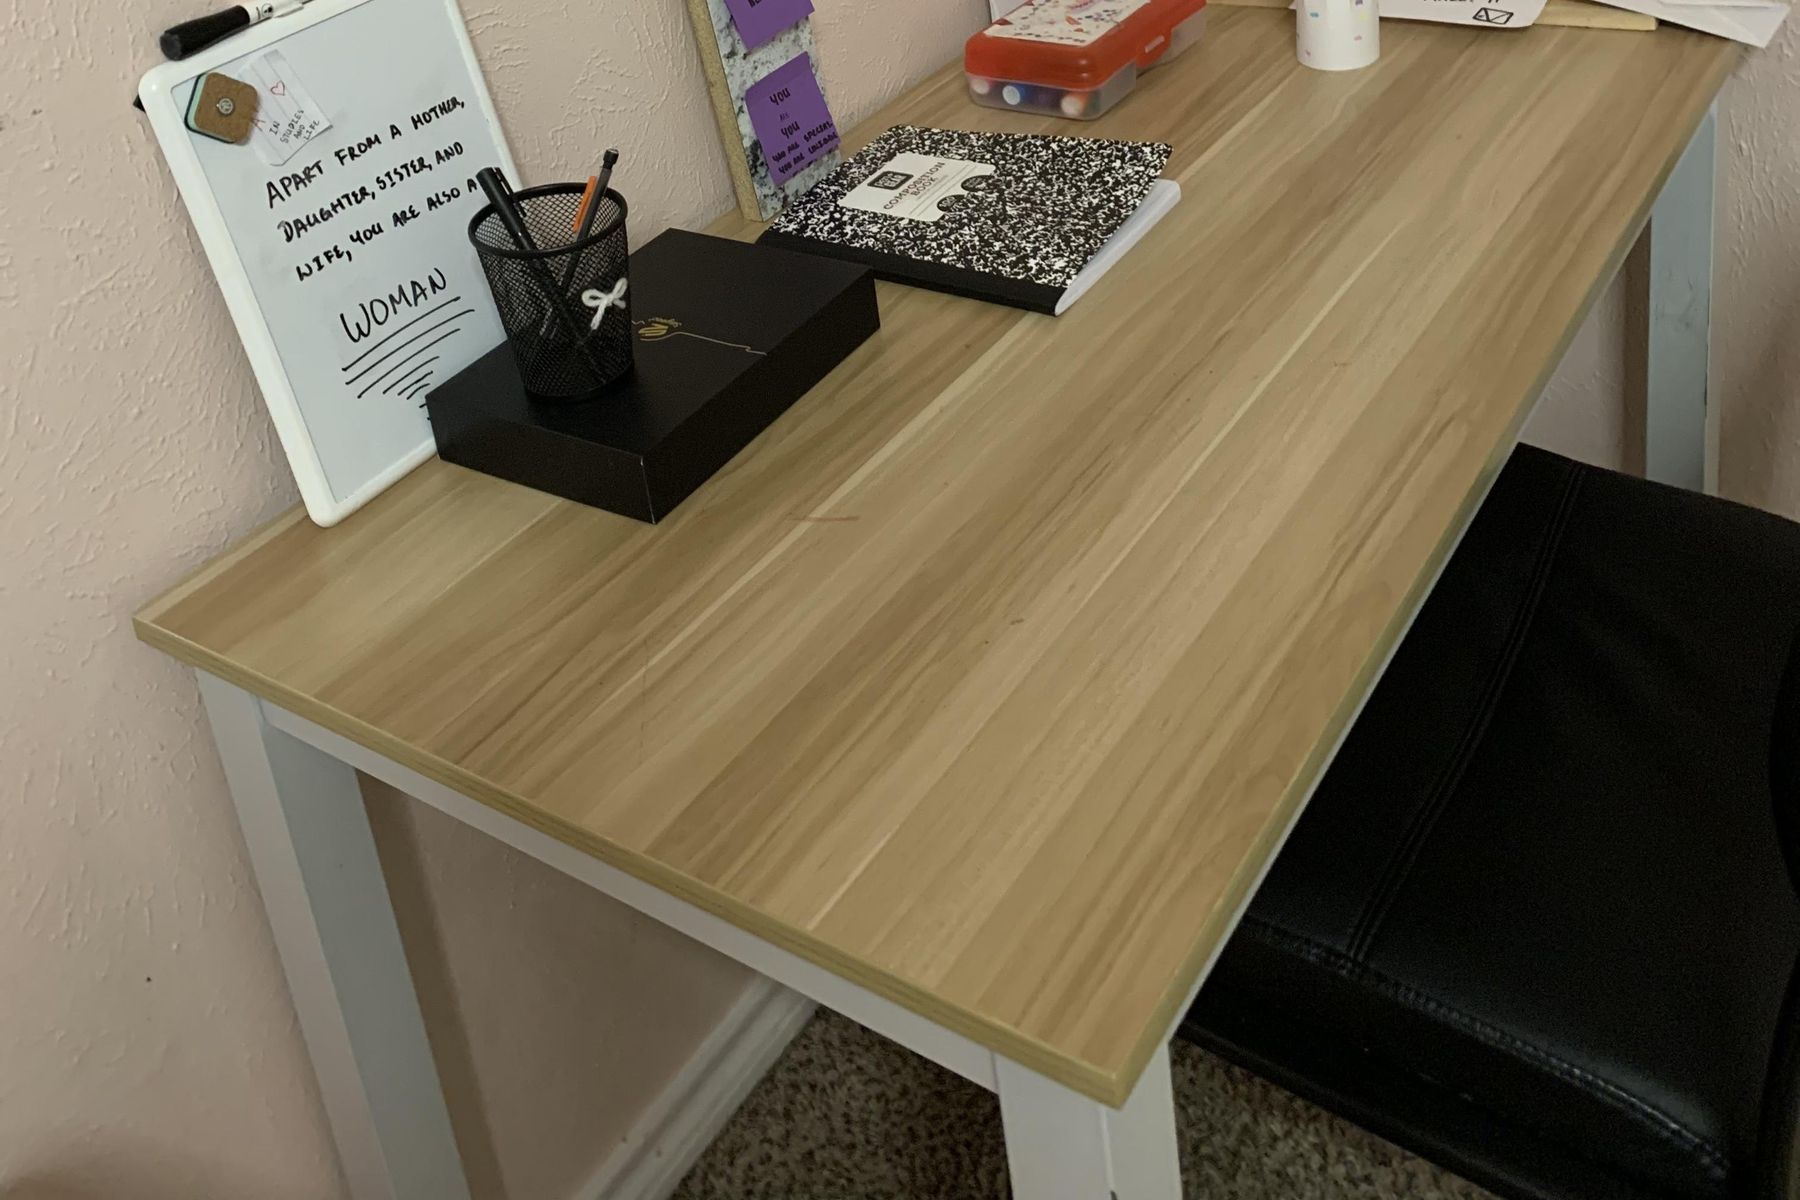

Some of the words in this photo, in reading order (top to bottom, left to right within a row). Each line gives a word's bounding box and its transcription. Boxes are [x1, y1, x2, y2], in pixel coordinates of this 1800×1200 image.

[770, 87, 791, 106] YOU
[266, 160, 323, 209] APART
[334, 133, 382, 166] FROM
[389, 124, 402, 140] A
[410, 96, 465, 130] MOTHER,
[780, 120, 800, 139] YOU
[277, 186, 376, 243] DAUGHTER,
[376, 156, 433, 190] SISTER,
[434, 141, 464, 165] AND
[883, 161, 945, 210] COMPOSITION
[910, 176, 936, 196] BOOK
[296, 245, 352, 282] WIFE,
[349, 222, 384, 245] YOU
[392, 205, 420, 228] ARE
[426, 187, 461, 211] ALSO
[466, 178, 478, 193] A
[339, 267, 447, 343] WOMAN
